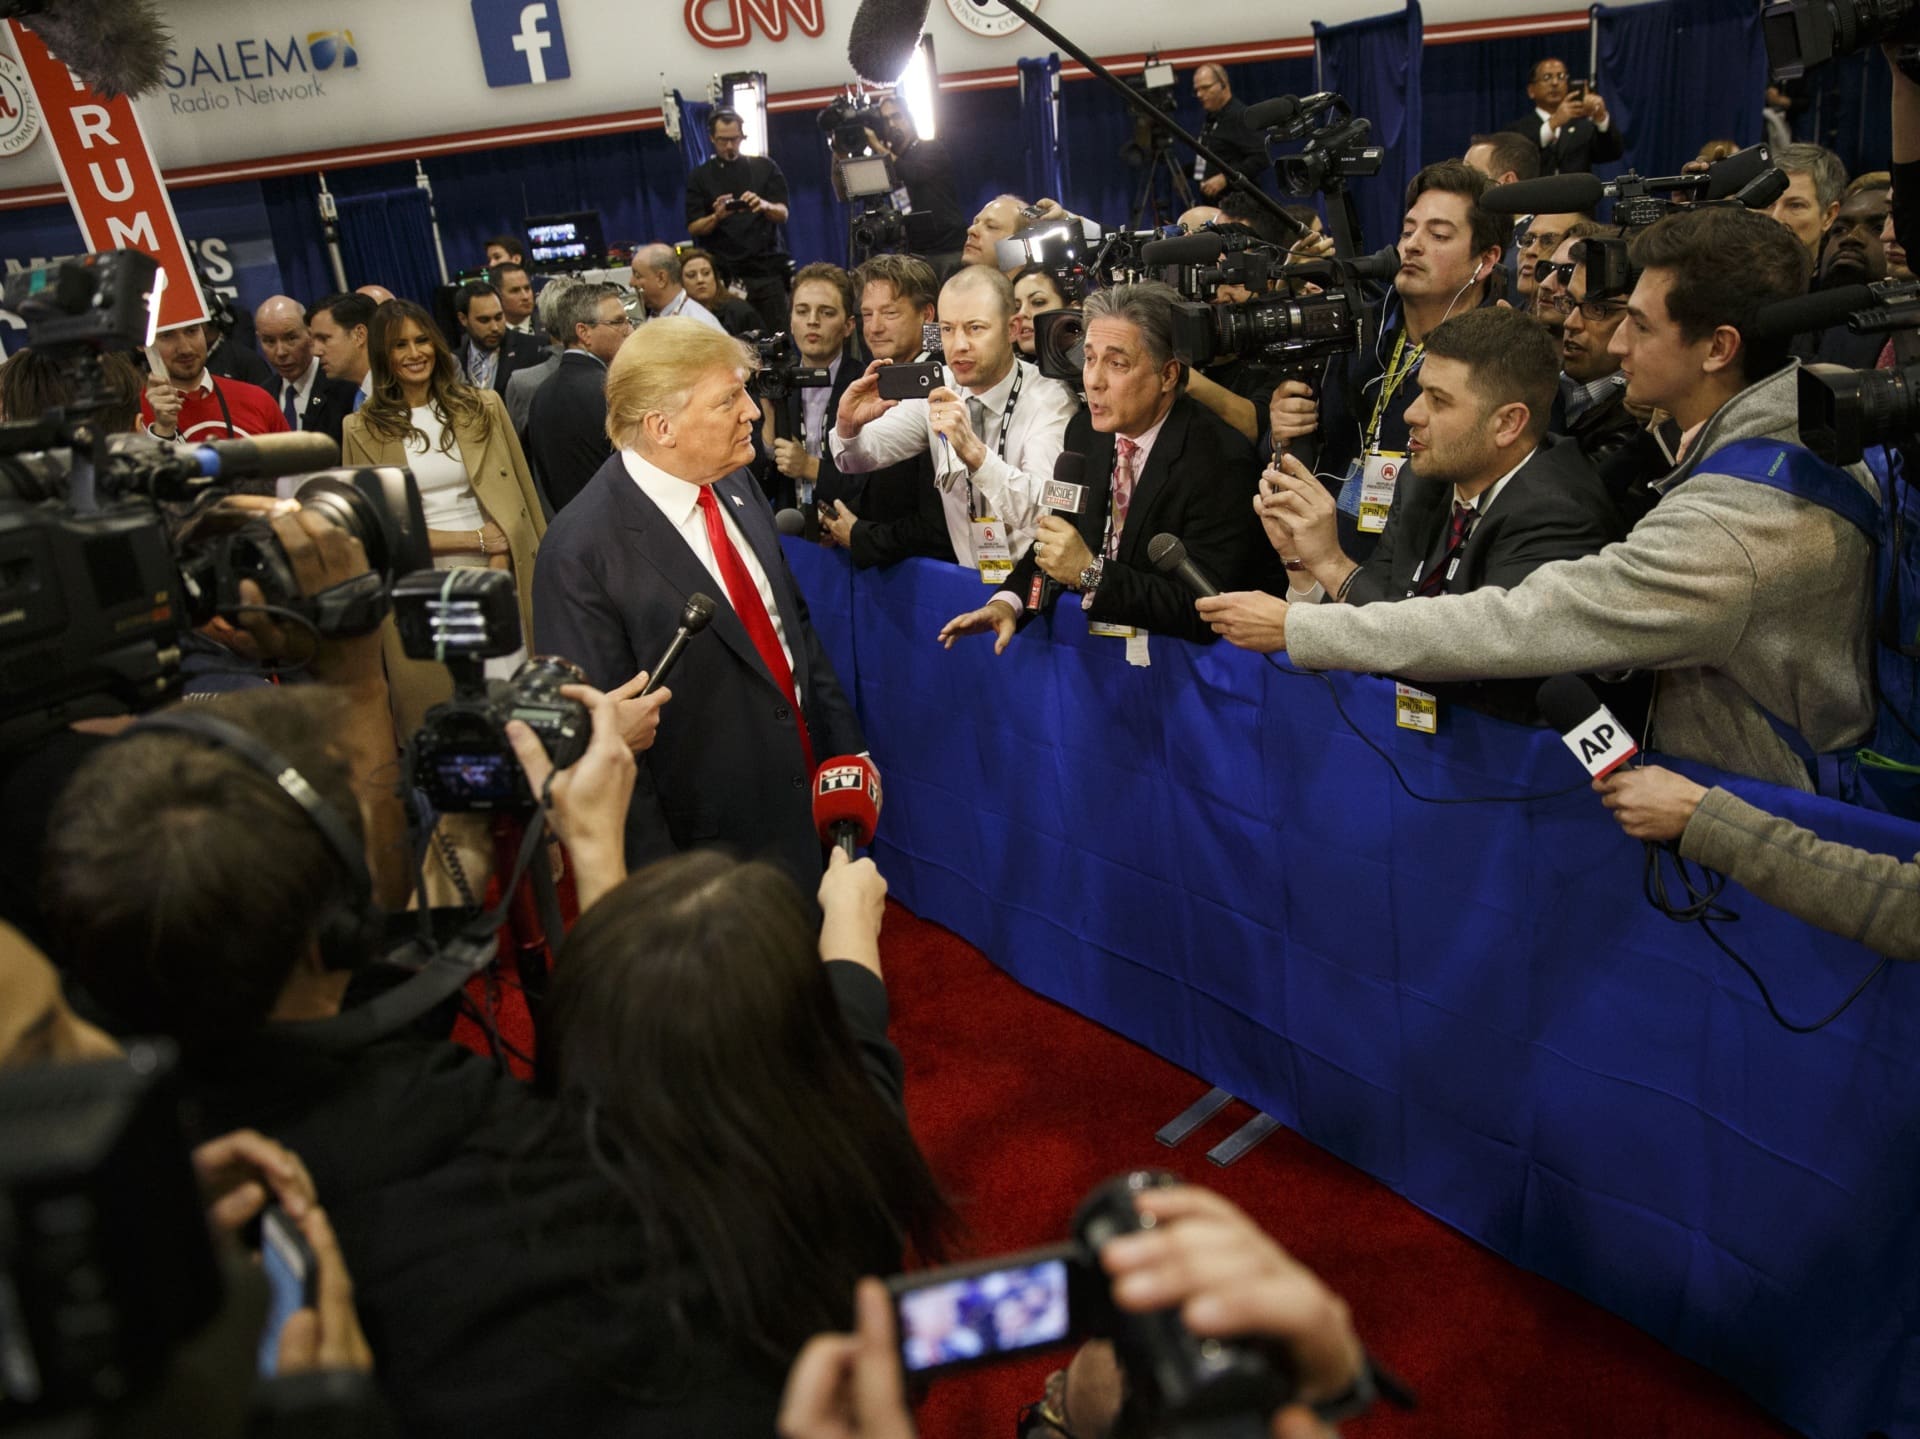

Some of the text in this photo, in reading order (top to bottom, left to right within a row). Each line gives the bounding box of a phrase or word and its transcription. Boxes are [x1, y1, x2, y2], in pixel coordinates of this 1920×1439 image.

[512, 2, 551, 84] f
[684, 0, 825, 49] CNN
[162, 35, 308, 89] SALEM
[169, 74, 327, 115] Radio Network
[1047, 484, 1074, 500] INSIDE
[1579, 723, 1615, 765] AP
[826, 775, 856, 790] TV
